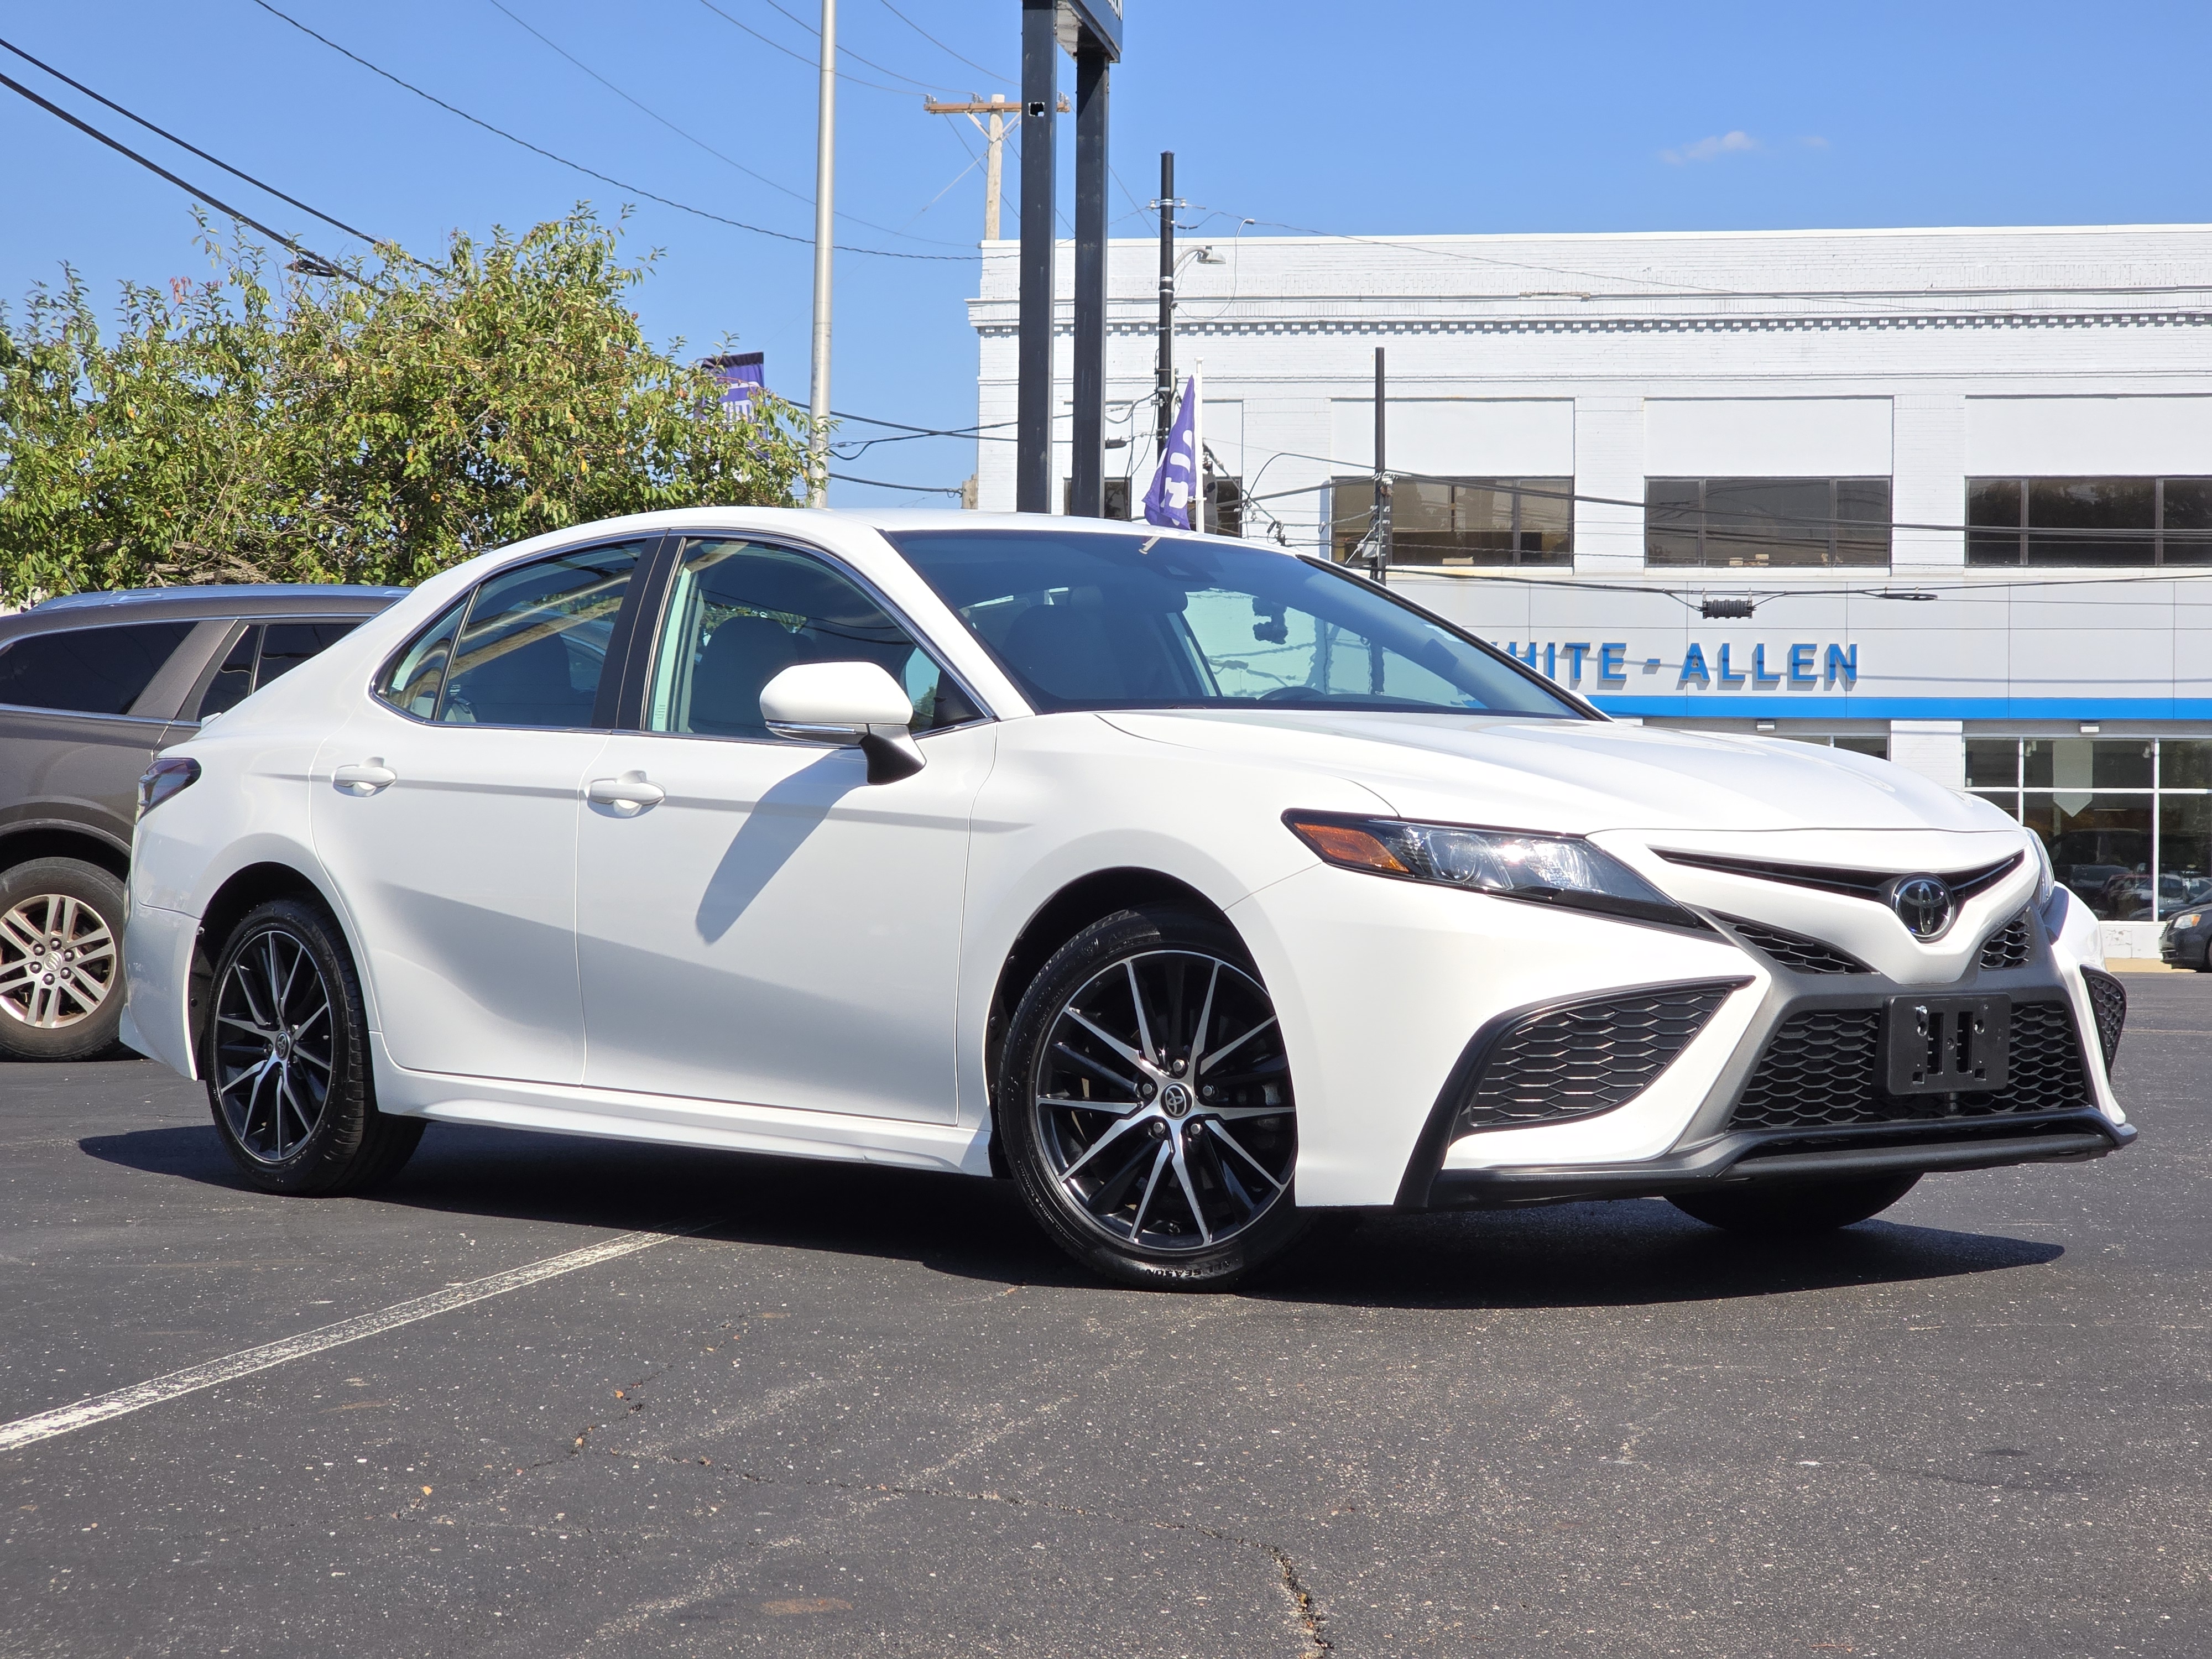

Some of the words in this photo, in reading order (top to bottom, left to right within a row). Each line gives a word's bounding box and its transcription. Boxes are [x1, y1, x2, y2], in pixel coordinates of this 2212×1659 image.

[1491, 641, 1627, 680] HITE
[1679, 643, 1858, 681] ALLEN
[1145, 1267, 1202, 1278] SEASON
